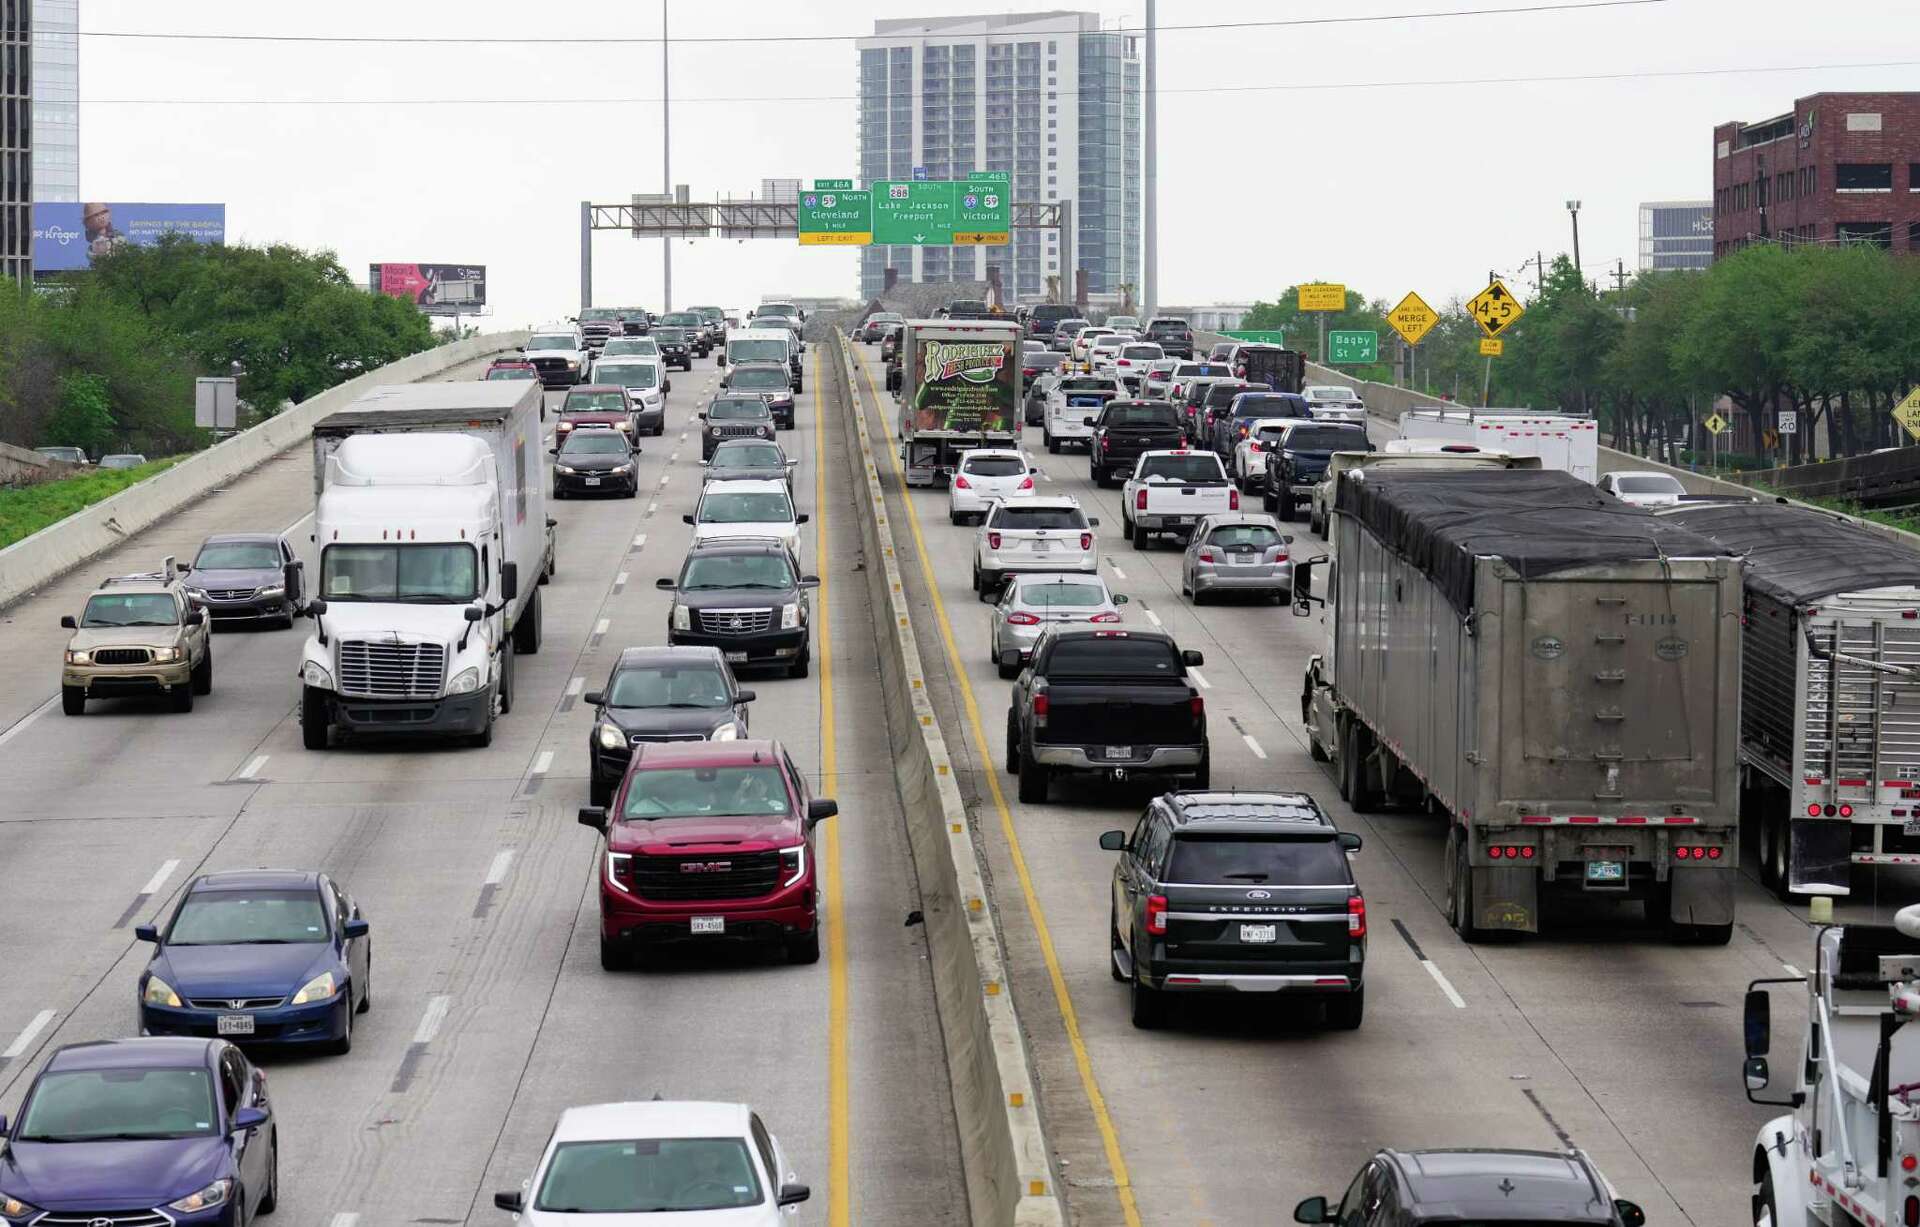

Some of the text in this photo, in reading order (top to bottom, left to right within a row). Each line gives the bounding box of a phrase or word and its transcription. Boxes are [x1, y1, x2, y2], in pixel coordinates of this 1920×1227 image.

[890, 188, 908, 198] 288
[969, 185, 994, 193] SOUTH
[878, 201, 949, 209] Lake Jackson
[811, 211, 859, 219] Cleveland
[893, 213, 934, 221] Freeport
[963, 212, 1000, 220] Victoria
[45, 226, 80, 245] Kroger
[1398, 314, 1427, 322] MERGE
[1402, 324, 1423, 333] LEFT
[1335, 335, 1370, 346] Bagby
[1336, 349, 1349, 357] St
[680, 861, 732, 873] GMC
